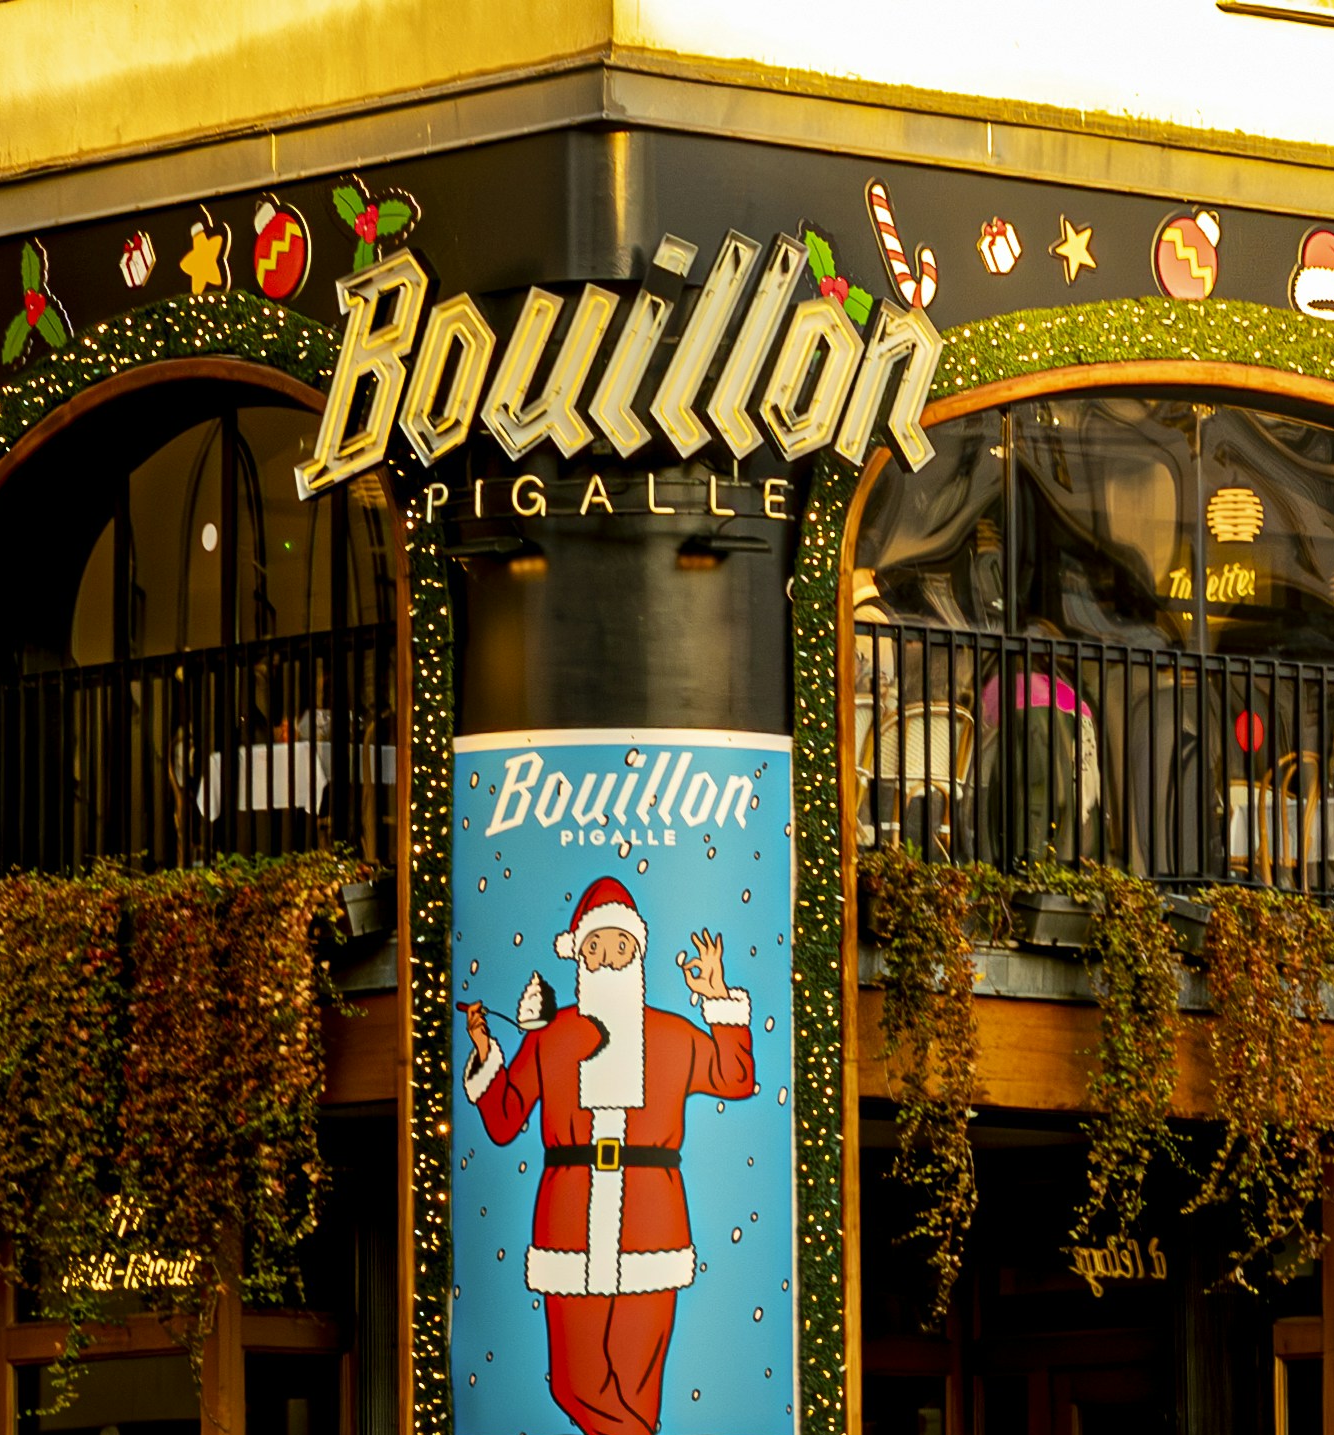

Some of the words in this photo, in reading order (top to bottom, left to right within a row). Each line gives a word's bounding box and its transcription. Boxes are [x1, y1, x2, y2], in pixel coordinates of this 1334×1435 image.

[293, 229, 943, 502] Bouillon
[426, 472, 795, 524] PIGALLE
[484, 749, 755, 838] Bouillon
[559, 827, 677, 848] PIGALLE
